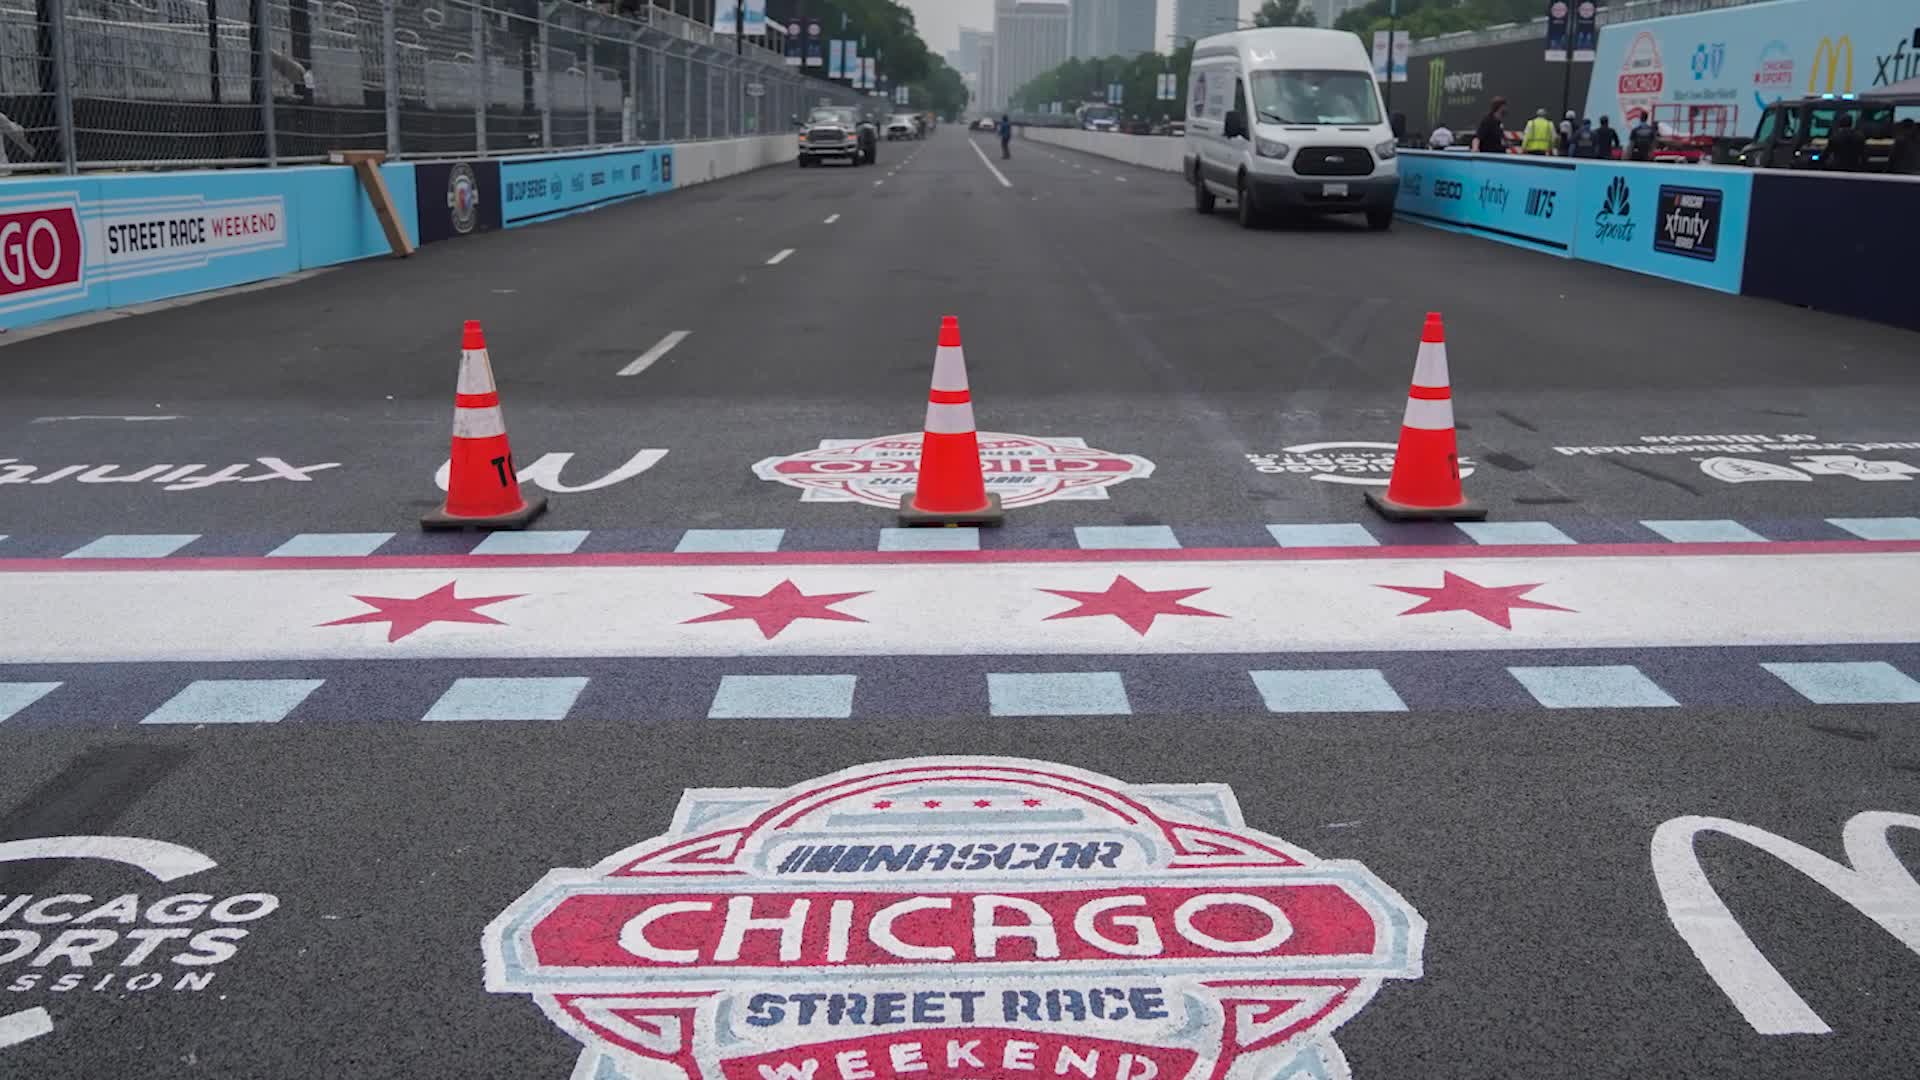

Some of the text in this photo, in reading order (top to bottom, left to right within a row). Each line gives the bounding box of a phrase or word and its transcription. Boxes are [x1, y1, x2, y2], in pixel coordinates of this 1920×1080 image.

[108, 213, 277, 254] STREET RACE WEEKEND
[1595, 210, 1636, 243] Sports
[1664, 208, 1710, 245] xfinity
[0, 457, 342, 490] xfinit
[811, 459, 1099, 474] CHIGO
[1255, 464, 1395, 473] ICAGO
[863, 841, 1124, 874] NASCAR
[0, 892, 280, 924] ICAGO
[617, 893, 1294, 963] CHICAGO
[6, 972, 216, 992] SSION
[745, 987, 1170, 1027] STREET RACE
[759, 1039, 1159, 1080] WEEKEND
